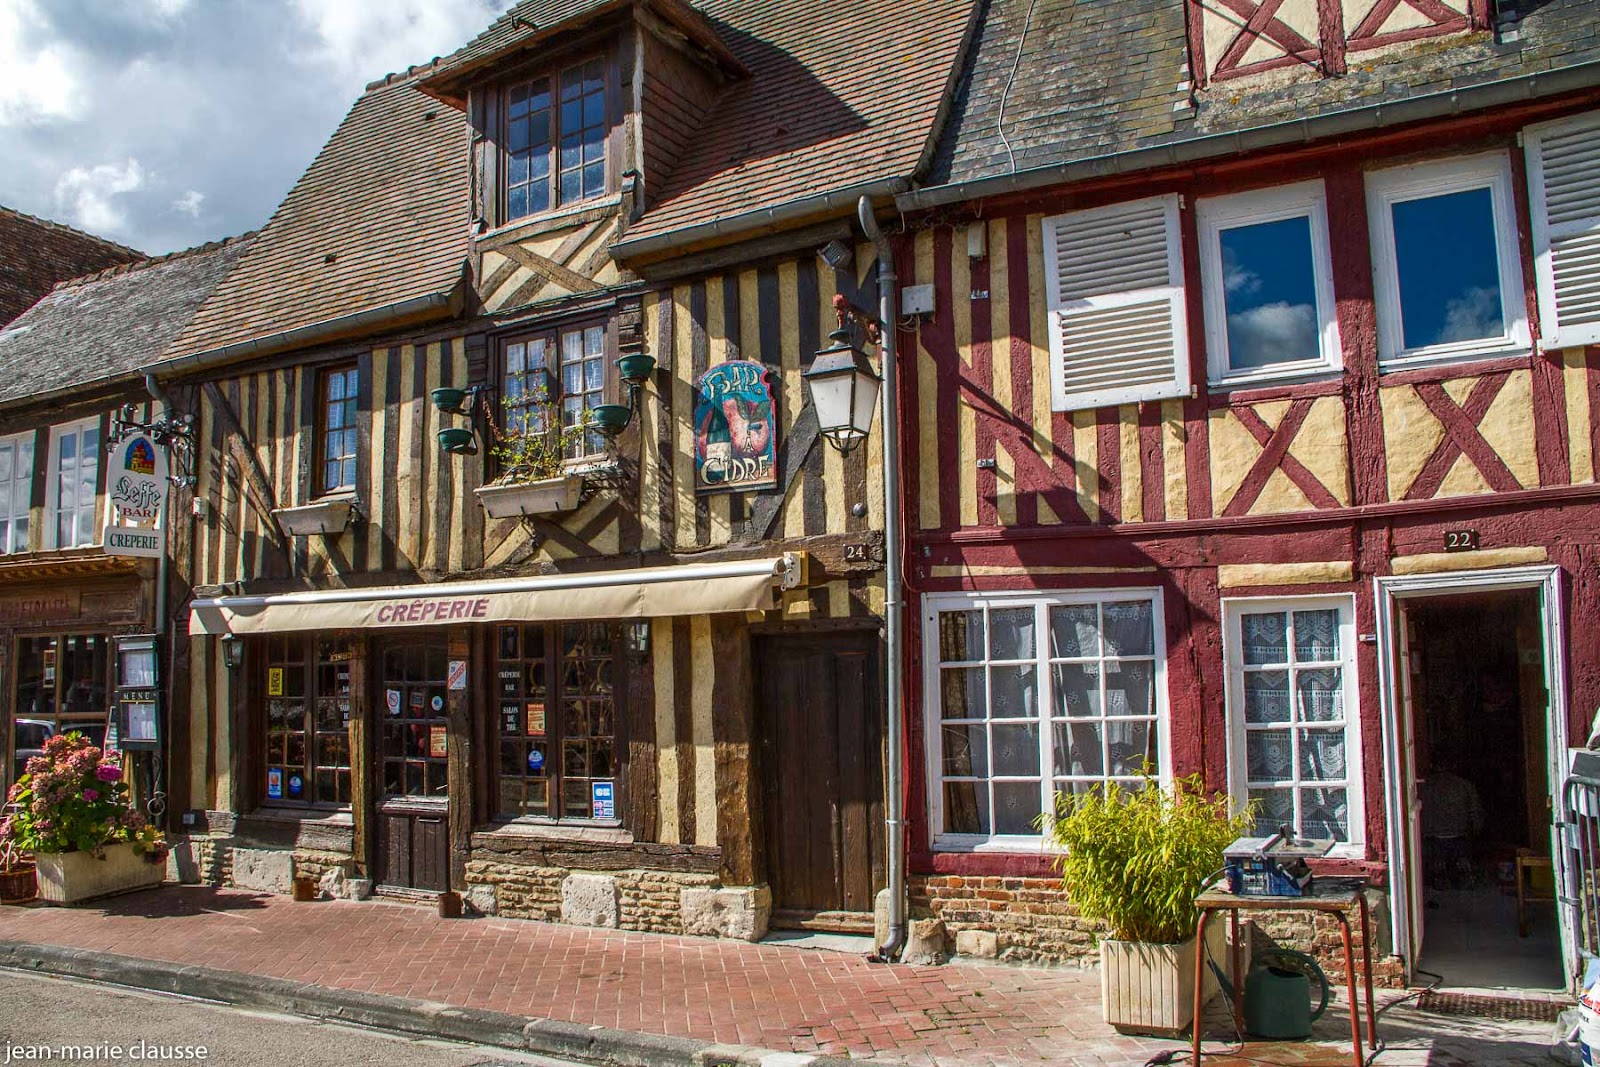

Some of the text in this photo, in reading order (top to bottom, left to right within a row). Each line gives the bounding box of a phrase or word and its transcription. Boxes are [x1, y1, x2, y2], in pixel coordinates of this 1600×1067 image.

[701, 455, 769, 485] CIDRE
[112, 475, 161, 509] Leffe
[122, 507, 152, 518] BAR
[110, 533, 159, 550] CREPERIE
[1449, 532, 1471, 547] 22
[847, 546, 864, 558] 24
[377, 599, 490, 623] CRÊPERIE
[123, 692, 151, 700] MENU
[507, 715, 515, 723] DE
